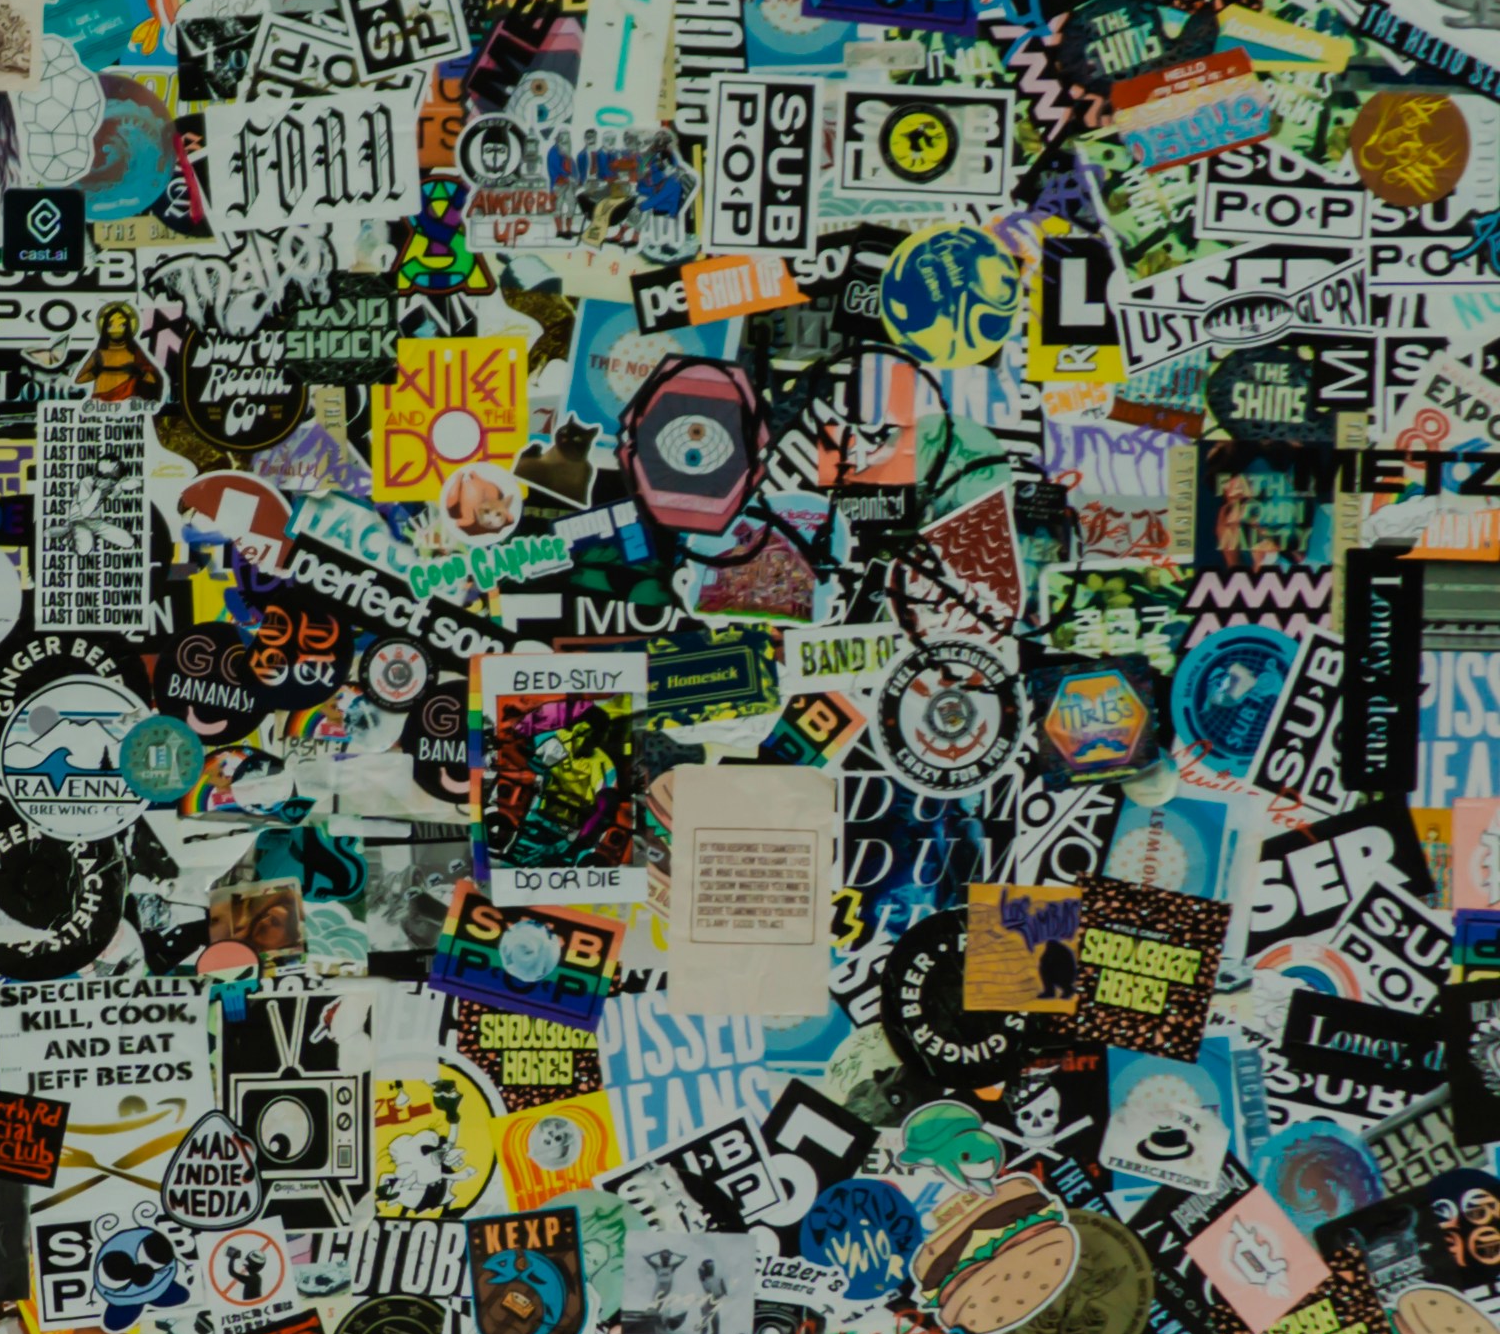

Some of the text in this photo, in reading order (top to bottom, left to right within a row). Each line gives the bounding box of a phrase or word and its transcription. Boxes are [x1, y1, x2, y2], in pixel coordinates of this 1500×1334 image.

[19, 249, 68, 261] cast.ai
[0, 978, 205, 1007] SPECIFICALLY
[21, 1007, 196, 1031] KILL, COOK,
[44, 1034, 171, 1059] AND EAT
[27, 1062, 192, 1093] JEFF BEZOS
[186, 1134, 238, 1163] MAD
[175, 1163, 240, 1190] INDIE
[168, 1188, 252, 1220] MEDIA
